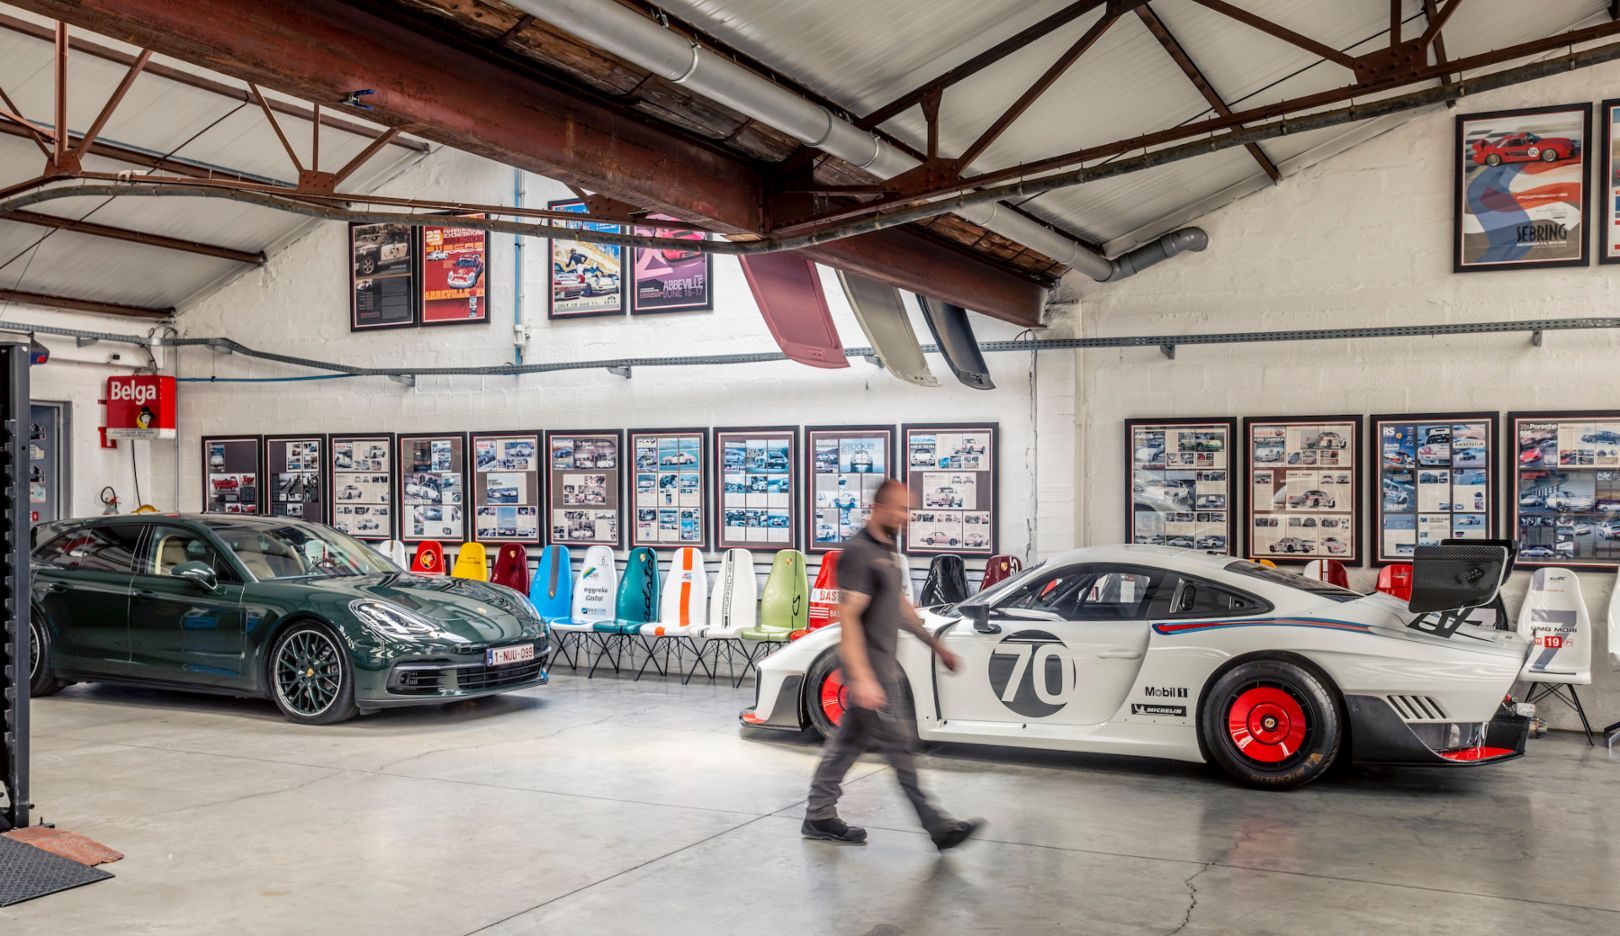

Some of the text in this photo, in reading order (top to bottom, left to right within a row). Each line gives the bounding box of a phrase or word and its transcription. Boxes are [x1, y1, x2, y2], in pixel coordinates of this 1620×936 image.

[1516, 223, 1567, 242] SEBRING
[663, 277, 704, 292] ABBEVILLE
[111, 379, 156, 406] Belga
[1383, 426, 1396, 436] RS
[724, 563, 734, 615] PORSCHE
[1546, 637, 1560, 647] 19
[994, 643, 1074, 705] 70
[1145, 686, 1176, 698] Mobil
